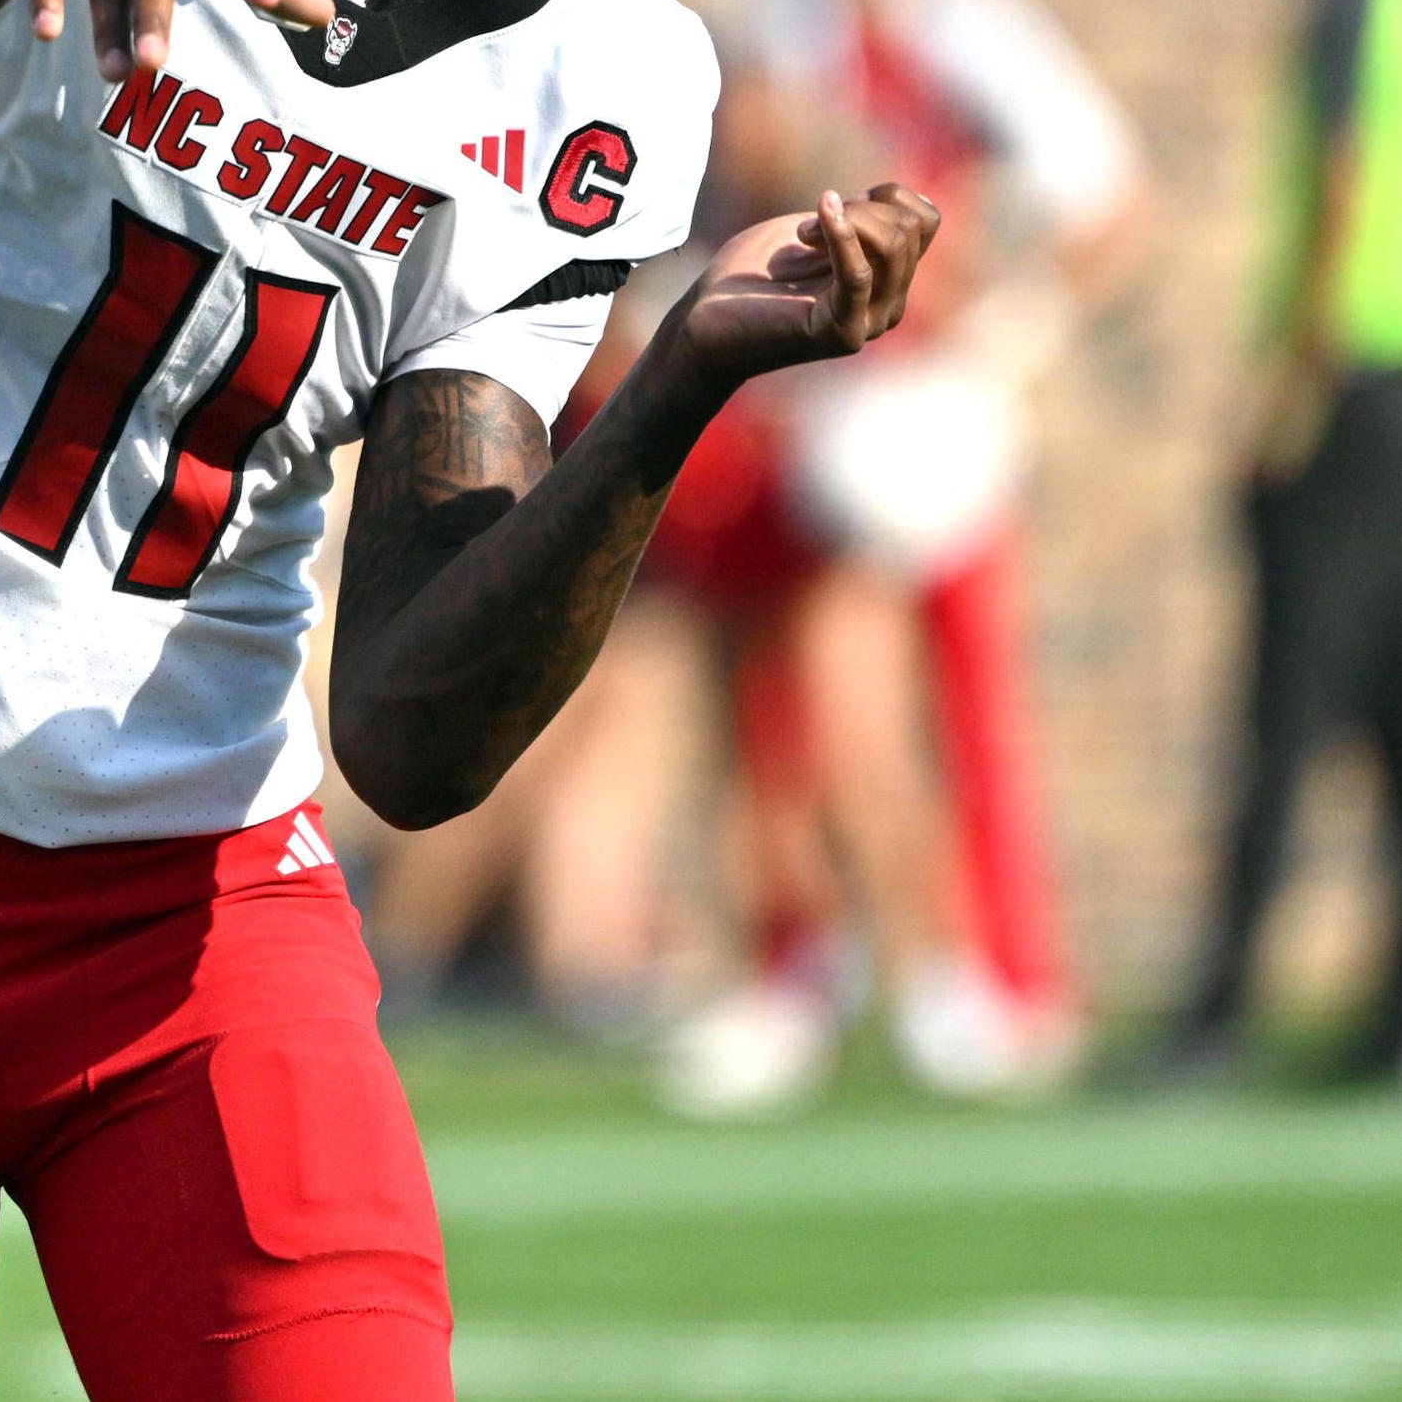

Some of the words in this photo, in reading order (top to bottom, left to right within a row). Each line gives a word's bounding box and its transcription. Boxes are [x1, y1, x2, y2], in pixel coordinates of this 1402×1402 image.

[99, 67, 224, 171] NC
[217, 119, 453, 256] STATE
[538, 119, 638, 238] C
